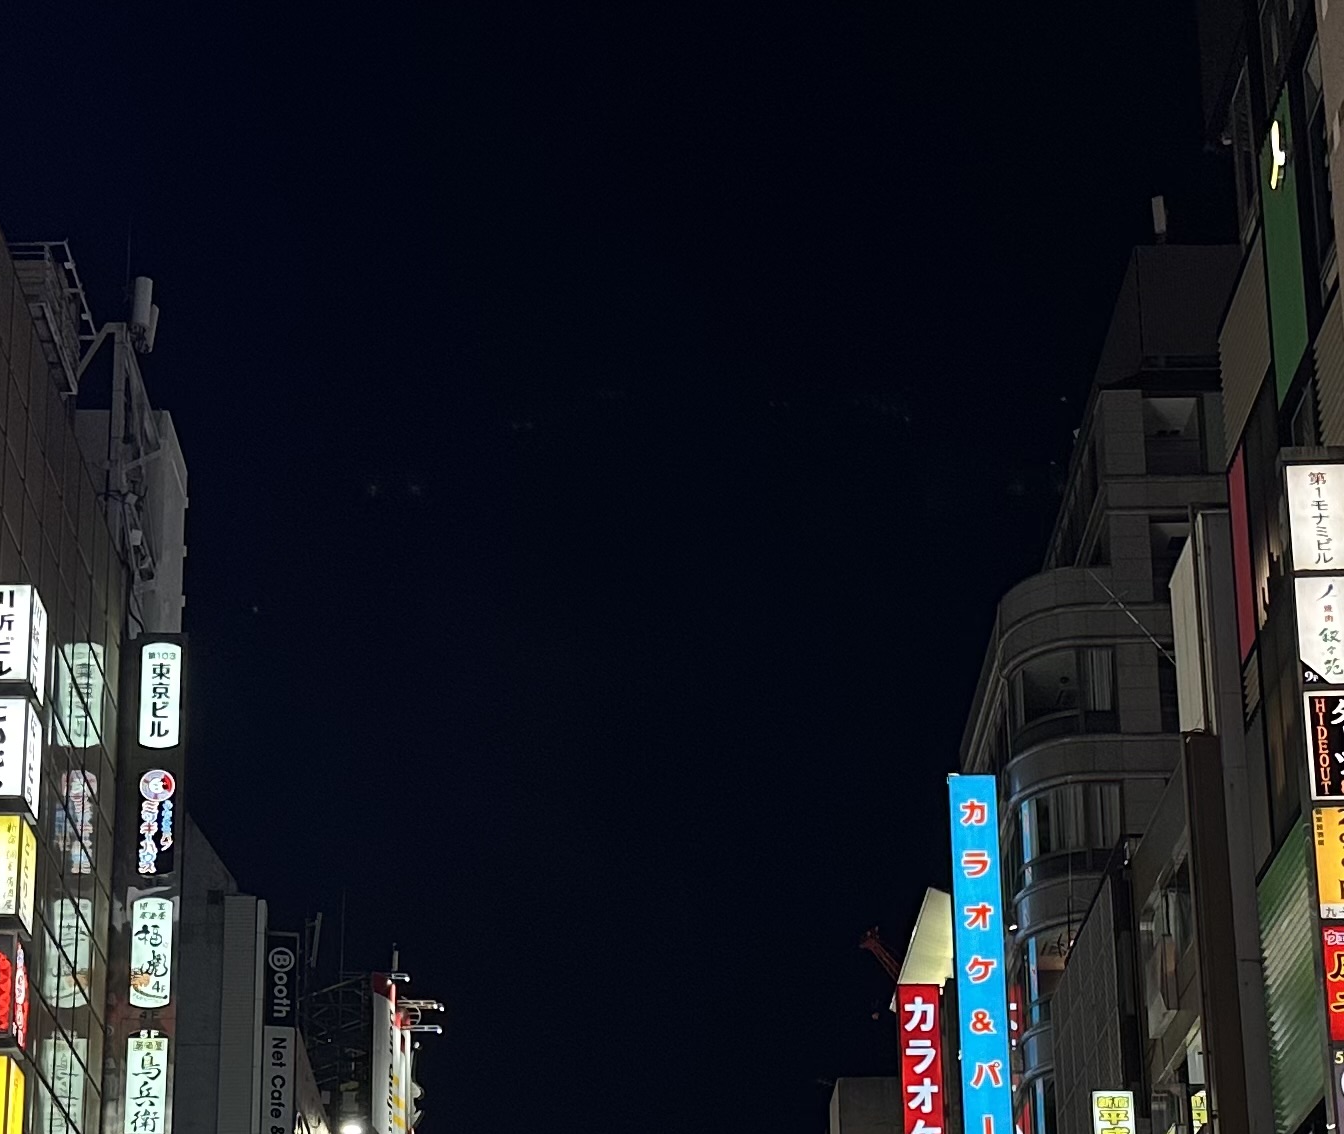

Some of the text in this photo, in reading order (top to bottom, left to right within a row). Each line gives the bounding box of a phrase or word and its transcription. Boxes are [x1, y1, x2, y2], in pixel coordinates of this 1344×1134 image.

[1308, 471, 1334, 565] 第1モナミビル
[149, 662, 171, 738] 東京ビル
[1313, 697, 1332, 795] HIDEOUT
[268, 947, 295, 1018] Booth
[271, 1036, 287, 1061] Net
[270, 1073, 286, 1120] Cafe
